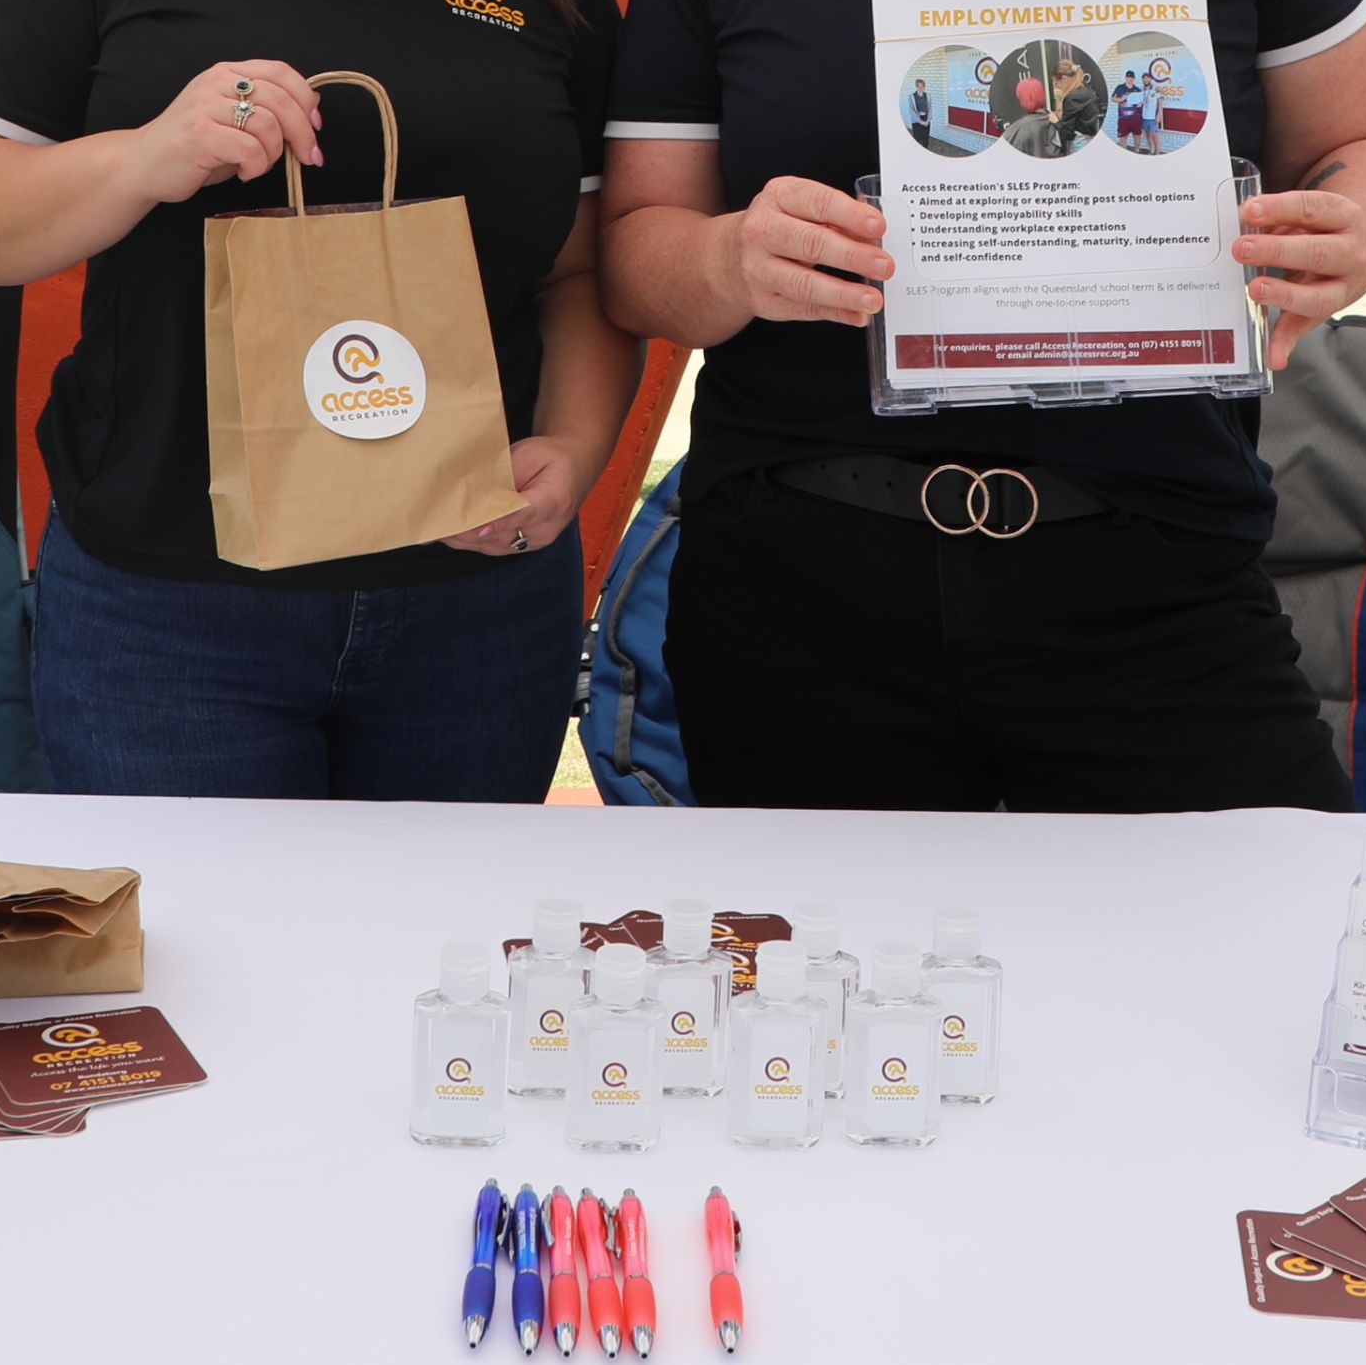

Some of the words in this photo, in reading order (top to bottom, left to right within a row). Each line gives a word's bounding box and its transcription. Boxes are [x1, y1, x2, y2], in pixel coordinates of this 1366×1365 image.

[451, 6, 521, 33] RECREATION
[920, 5, 1076, 27] EMPLOYMENT
[1082, 3, 1190, 23] SUPPORTS
[901, 183, 937, 193] Access
[940, 182, 1005, 192] Recreation's
[1007, 182, 1031, 191] SLES
[1033, 181, 1081, 193] Program:
[919, 197, 953, 206] Aimed
[955, 197, 967, 206] at
[969, 196, 1019, 208] exploring
[1021, 197, 1032, 205] or
[1035, 194, 1090, 206] expanding
[1092, 195, 1116, 205] post
[1118, 193, 1153, 203] school
[1155, 192, 1195, 204] options
[919, 211, 978, 222] Developing
[981, 209, 1053, 221] employability
[1055, 208, 1083, 218] skills
[920, 224, 998, 235] Understanding
[1000, 223, 1055, 234] workplace
[1057, 222, 1127, 233] expectations
[920, 239, 976, 250] Increasing
[978, 237, 1080, 249] self-understanding,
[1082, 236, 1133, 247] maturity,
[1135, 235, 1210, 247] independence
[921, 253, 941, 262] and
[943, 252, 1023, 263] self-confidence
[906, 286, 928, 296] SLES
[973, 285, 1000, 296] aligns
[1002, 285, 1022, 294] with
[1024, 284, 1040, 294] the
[1099, 282, 1130, 292] school
[1132, 283, 1155, 292] term
[1167, 282, 1175, 291] is
[996, 299, 1034, 310] through
[1089, 297, 1131, 308] supports
[995, 342, 1024, 353] please
[1025, 342, 1041, 351] call
[1129, 341, 1140, 349] on
[1141, 340, 1158, 349] (07)
[1159, 339, 1179, 348] 4151
[1181, 339, 1202, 348] 8019
[996, 352, 1006, 360] or
[1007, 351, 1032, 360] email
[321, 384, 414, 413] access
[331, 407, 410, 423] RECREATION
[33, 1041, 143, 1064] access
[46, 1053, 137, 1069] RECREATION
[50, 1081, 73, 1091] 07
[79, 1076, 115, 1087] 4151
[120, 1070, 163, 1083] 8019
[435, 1085, 485, 1096] access
[592, 1089, 641, 1101] access
[754, 1085, 803, 1096] access
[871, 1085, 920, 1096] access
